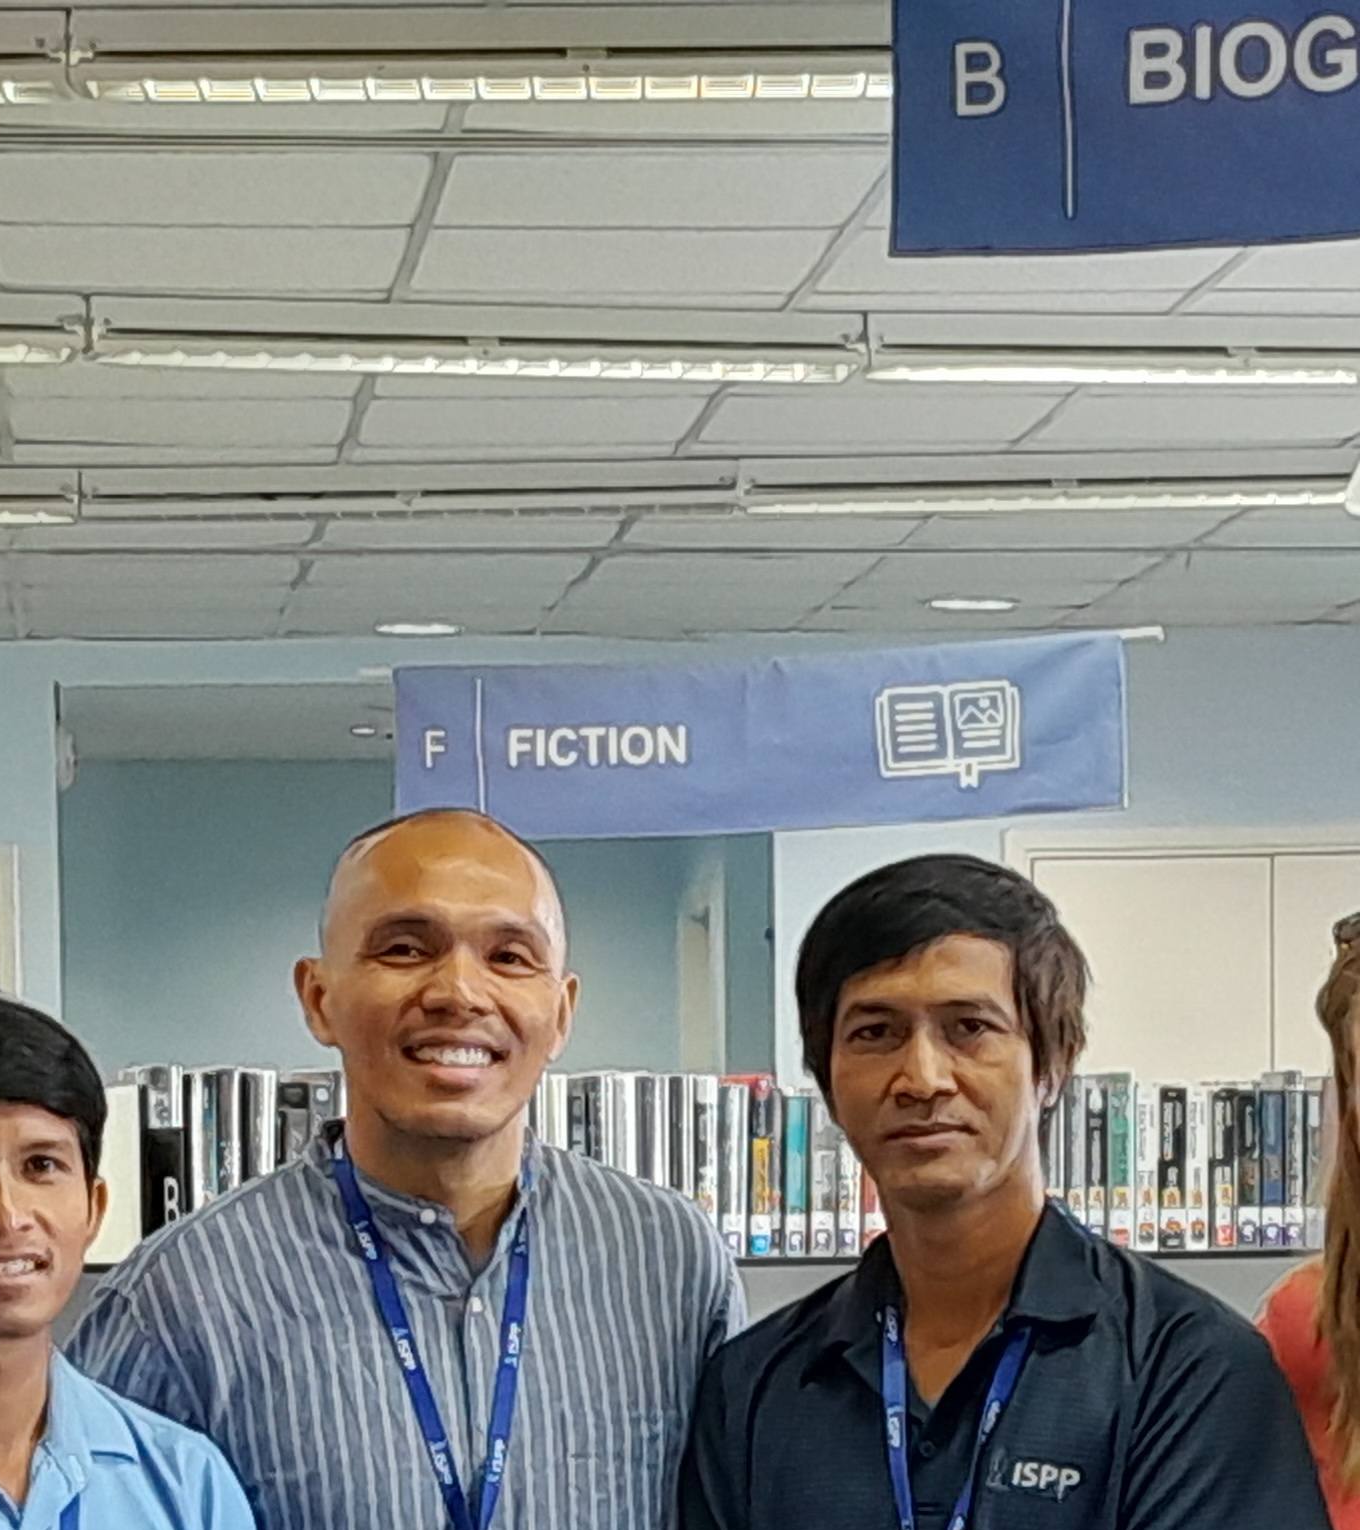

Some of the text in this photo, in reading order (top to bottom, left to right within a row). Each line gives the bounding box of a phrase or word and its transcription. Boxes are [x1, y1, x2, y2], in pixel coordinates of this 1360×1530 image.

[953, 42, 1007, 117] B
[424, 730, 447, 768] F
[507, 725, 689, 769] FICTION
[1012, 1461, 1081, 1503] ISPP
